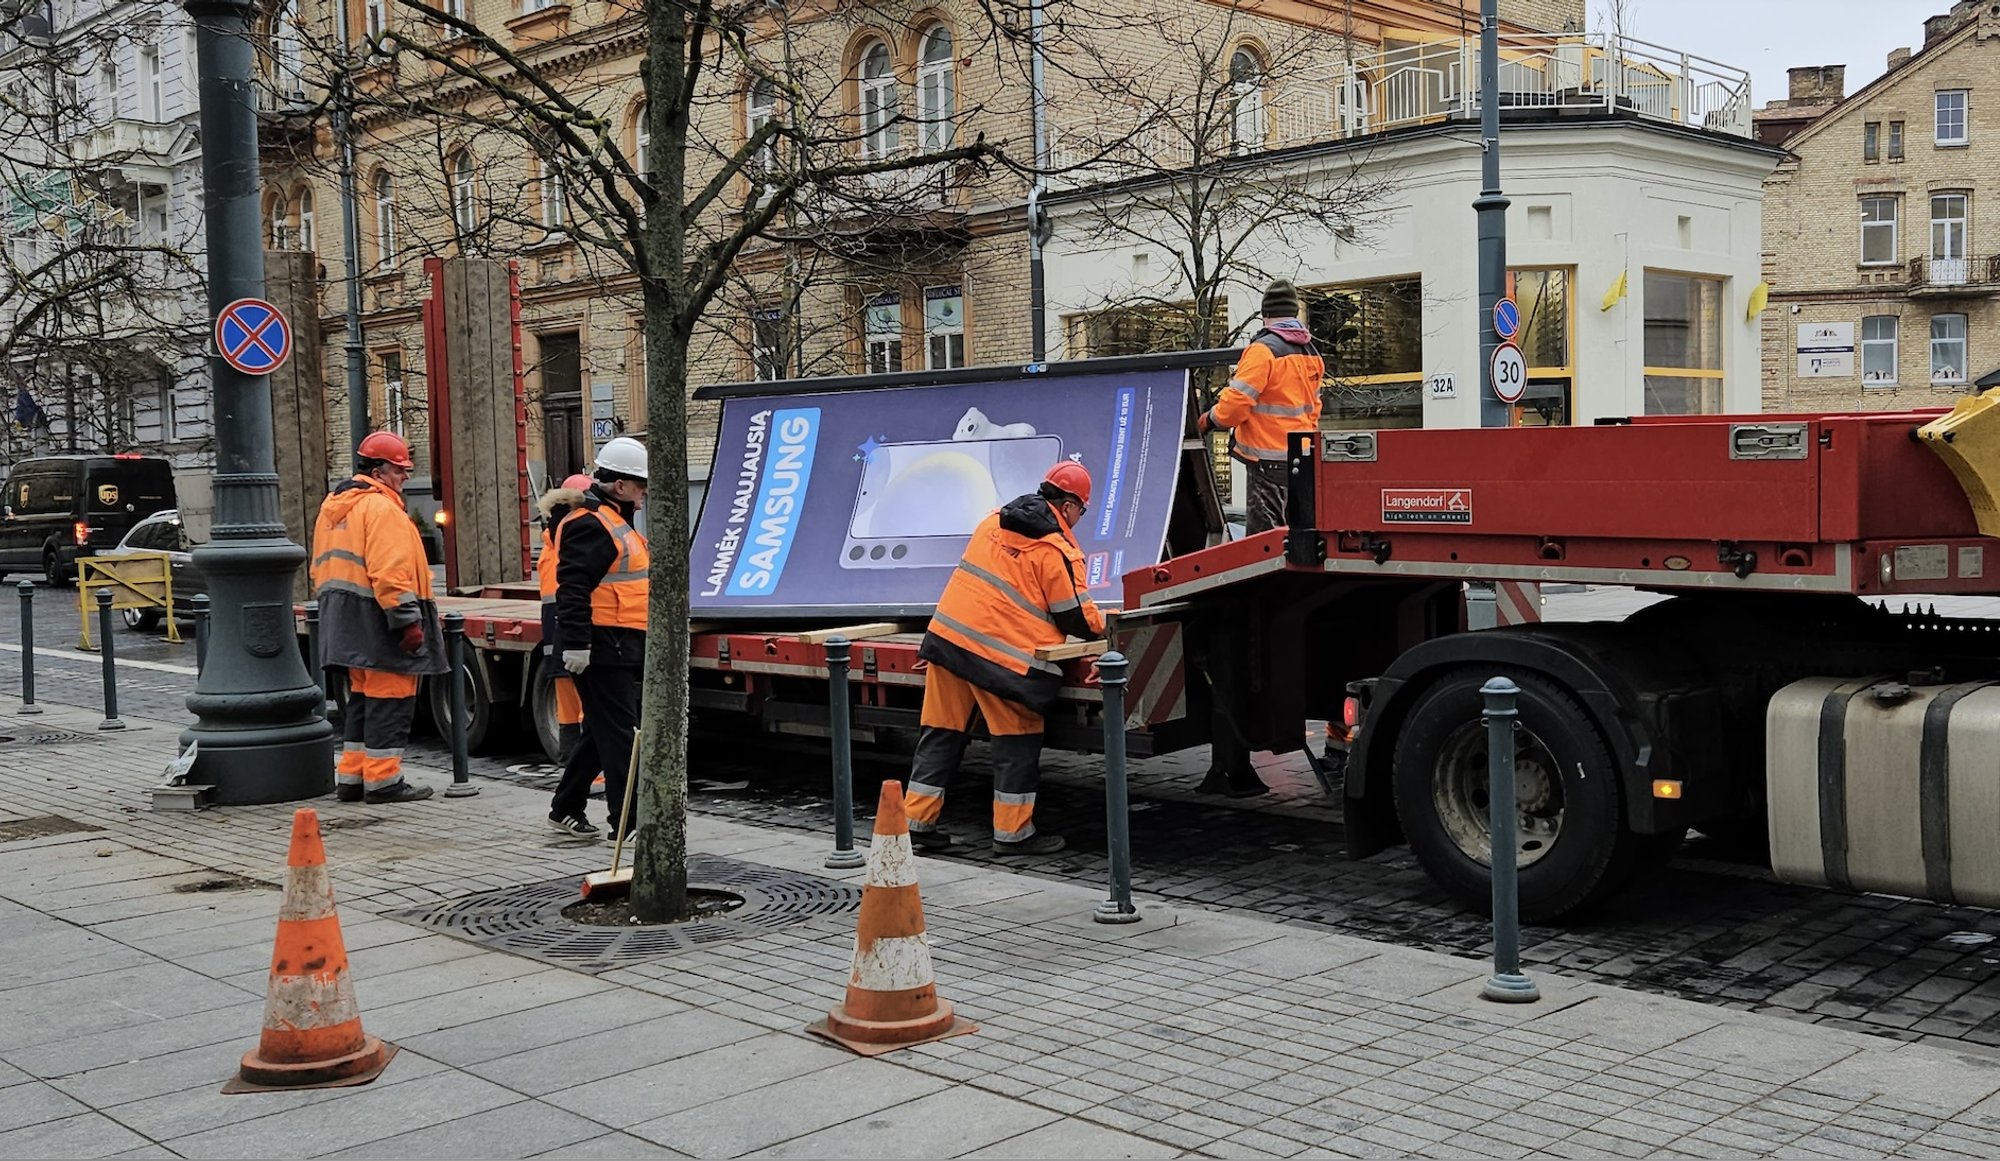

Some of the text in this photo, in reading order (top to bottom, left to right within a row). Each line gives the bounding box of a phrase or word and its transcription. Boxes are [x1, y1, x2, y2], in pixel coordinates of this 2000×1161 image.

[1500, 360, 1519, 384] 30
[1433, 377, 1453, 393] 32A
[1100, 509, 1112, 535] PILDANT
[1121, 393, 1130, 407] EUR
[100, 489, 118, 502] ups
[700, 409, 772, 597] LAIMĖK NAUJAUSIĄ
[739, 416, 810, 589] SAMSUNG
[1385, 495, 1443, 509] Langendorf
